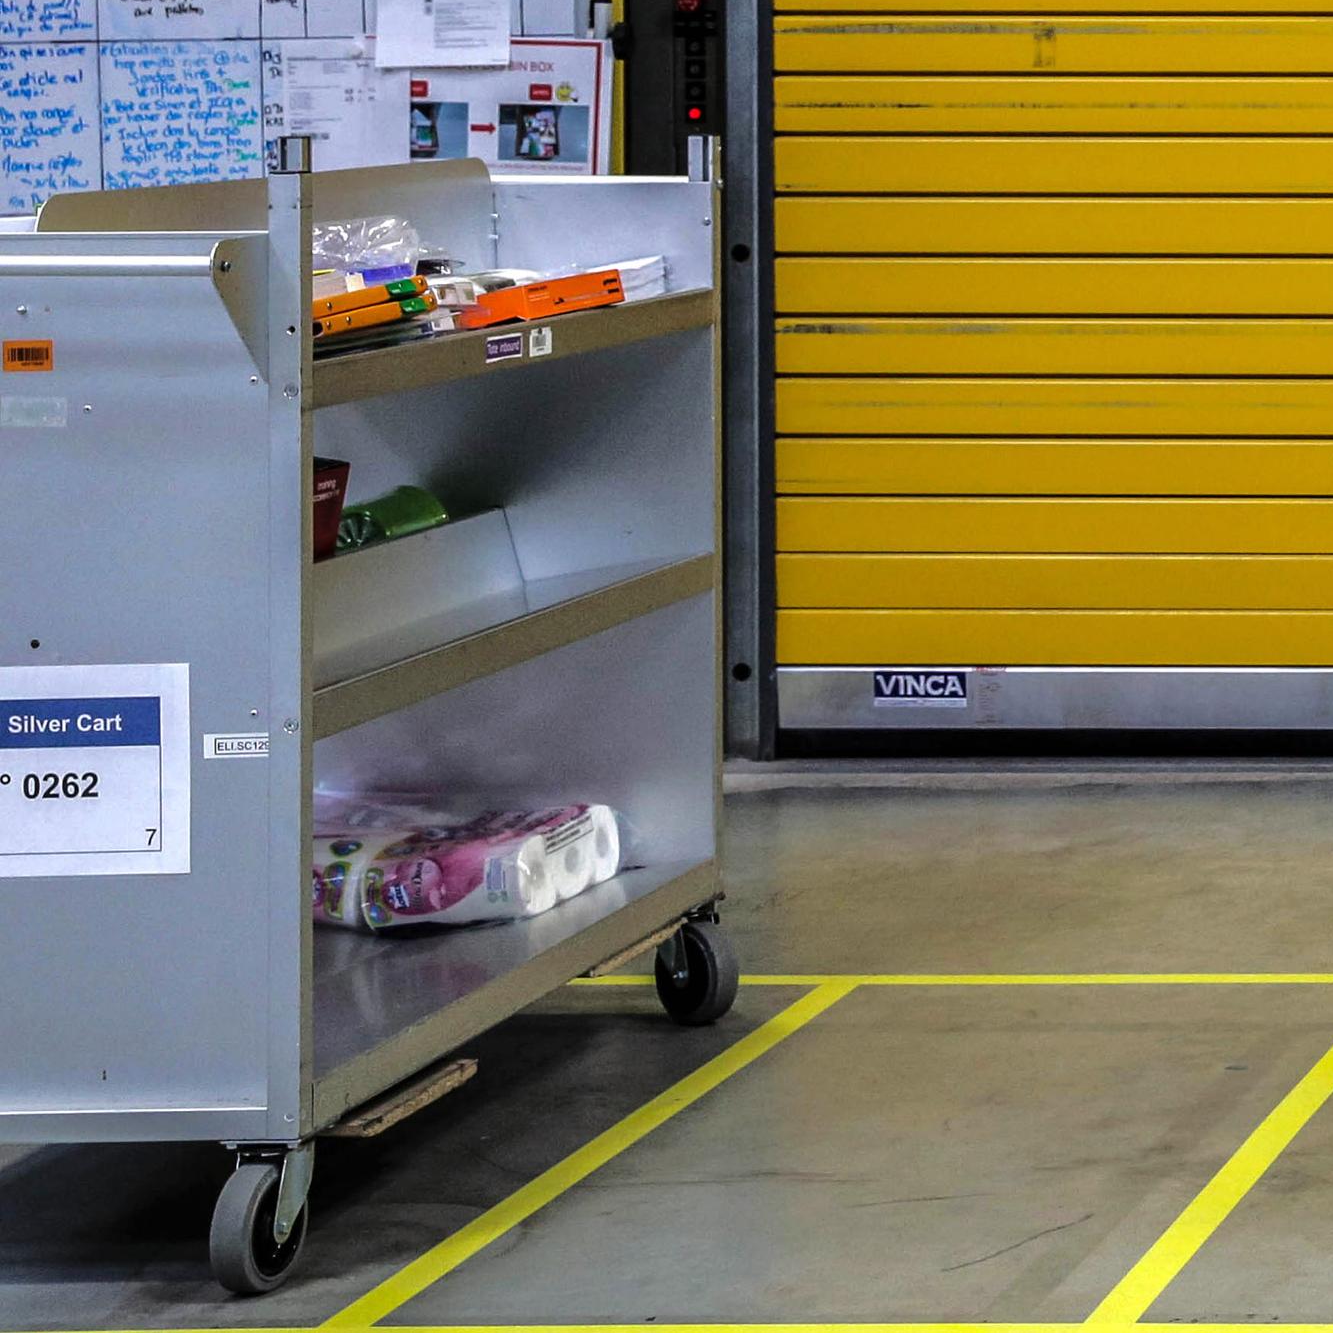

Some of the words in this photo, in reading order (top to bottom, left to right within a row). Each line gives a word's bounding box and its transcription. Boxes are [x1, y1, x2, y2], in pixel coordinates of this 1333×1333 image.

[529, 61, 555, 73] BOX
[876, 674, 964, 696] VINCA
[8, 714, 70, 734] Silver
[76, 713, 123, 732] Cart
[22, 771, 99, 799] 0262
[145, 828, 157, 846] 7
